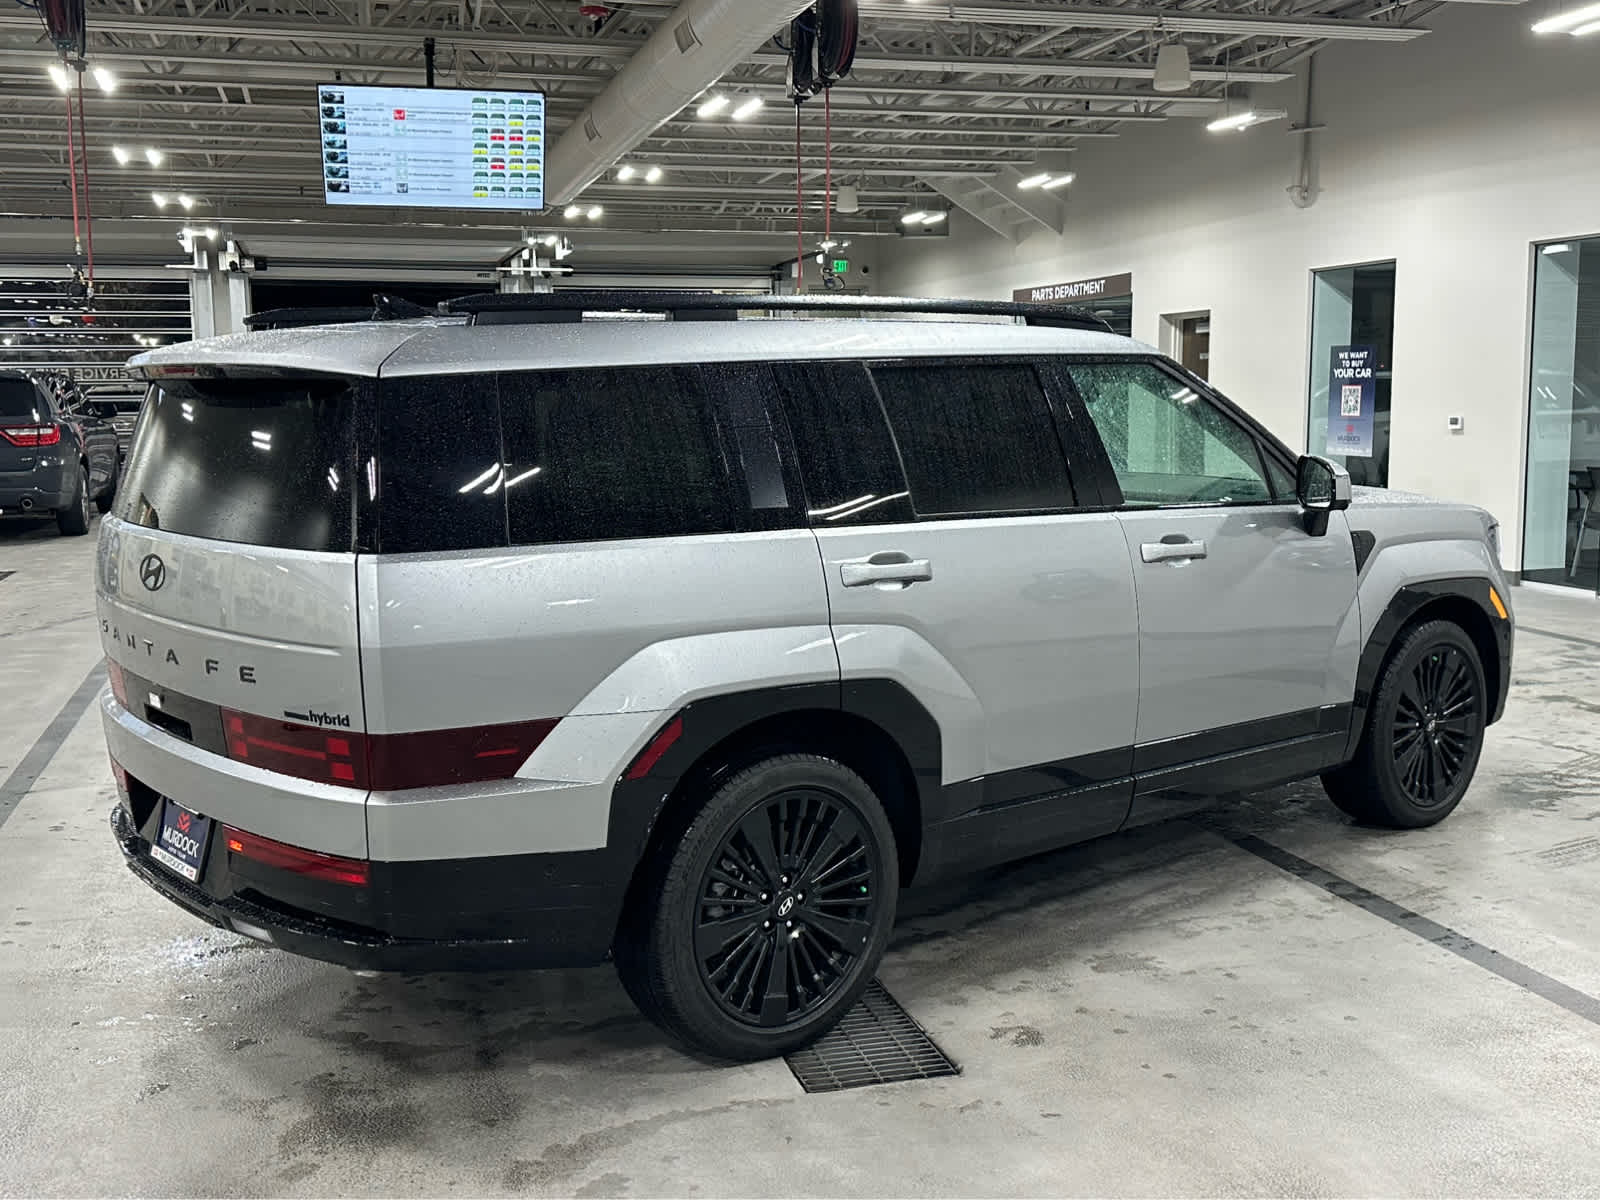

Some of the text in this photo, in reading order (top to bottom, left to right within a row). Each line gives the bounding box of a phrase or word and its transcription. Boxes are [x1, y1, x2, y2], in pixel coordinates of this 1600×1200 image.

[833, 260, 847, 272] EXIT
[1031, 280, 1106, 301] PARTS DEPARTMENT
[1338, 351, 1368, 360] WE WANT
[1333, 368, 1371, 378] YOUR CAR
[102, 619, 256, 683] SANTA FE
[309, 709, 350, 727] hybrid
[162, 824, 199, 858] MURDOCK
